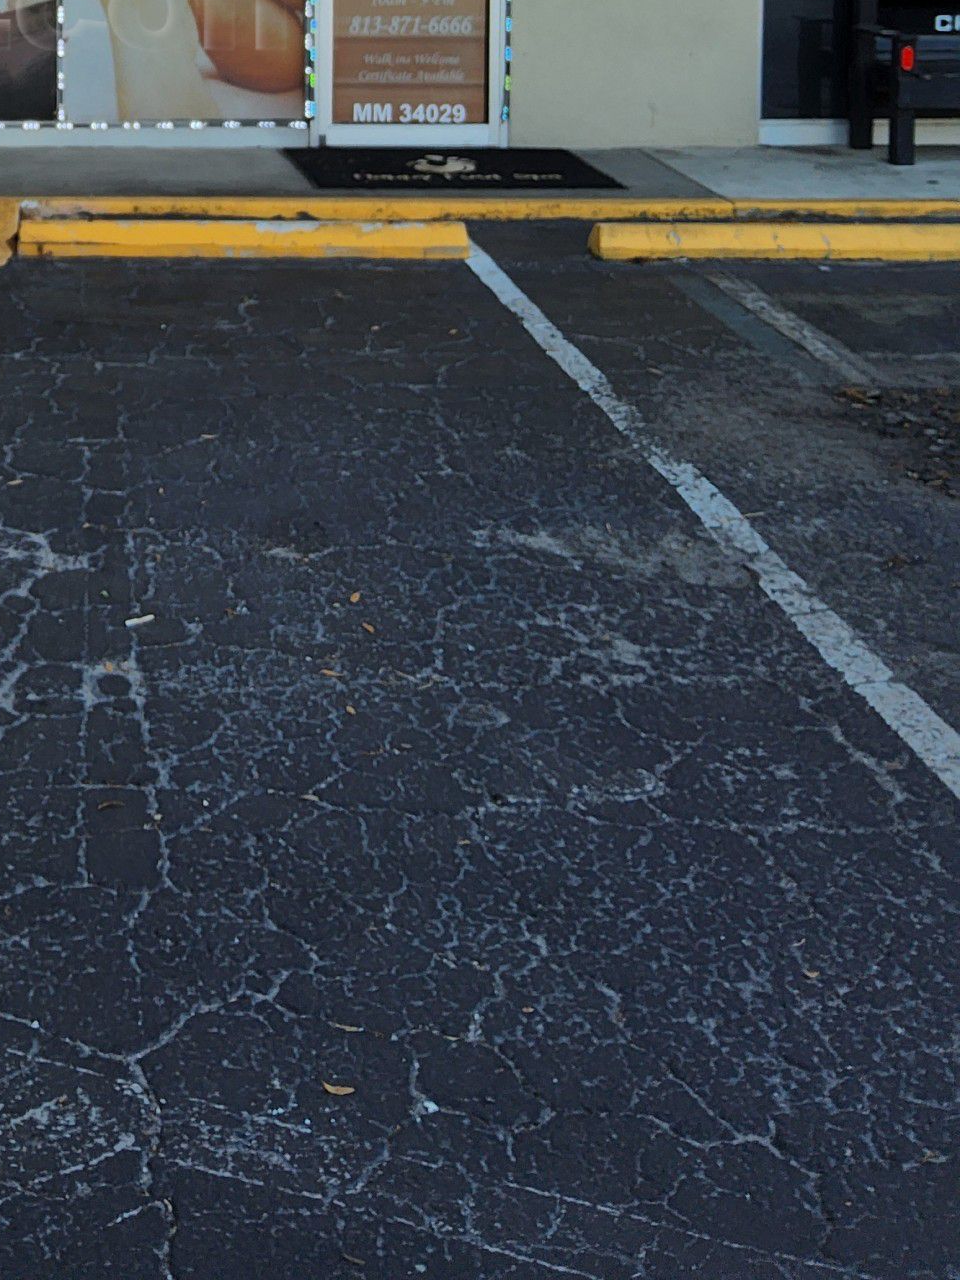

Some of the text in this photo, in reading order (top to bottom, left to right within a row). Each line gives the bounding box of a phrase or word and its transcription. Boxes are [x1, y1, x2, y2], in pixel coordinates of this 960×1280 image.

[349, 16, 473, 36] 813-871-6666
[353, 103, 466, 123] MM 34029
